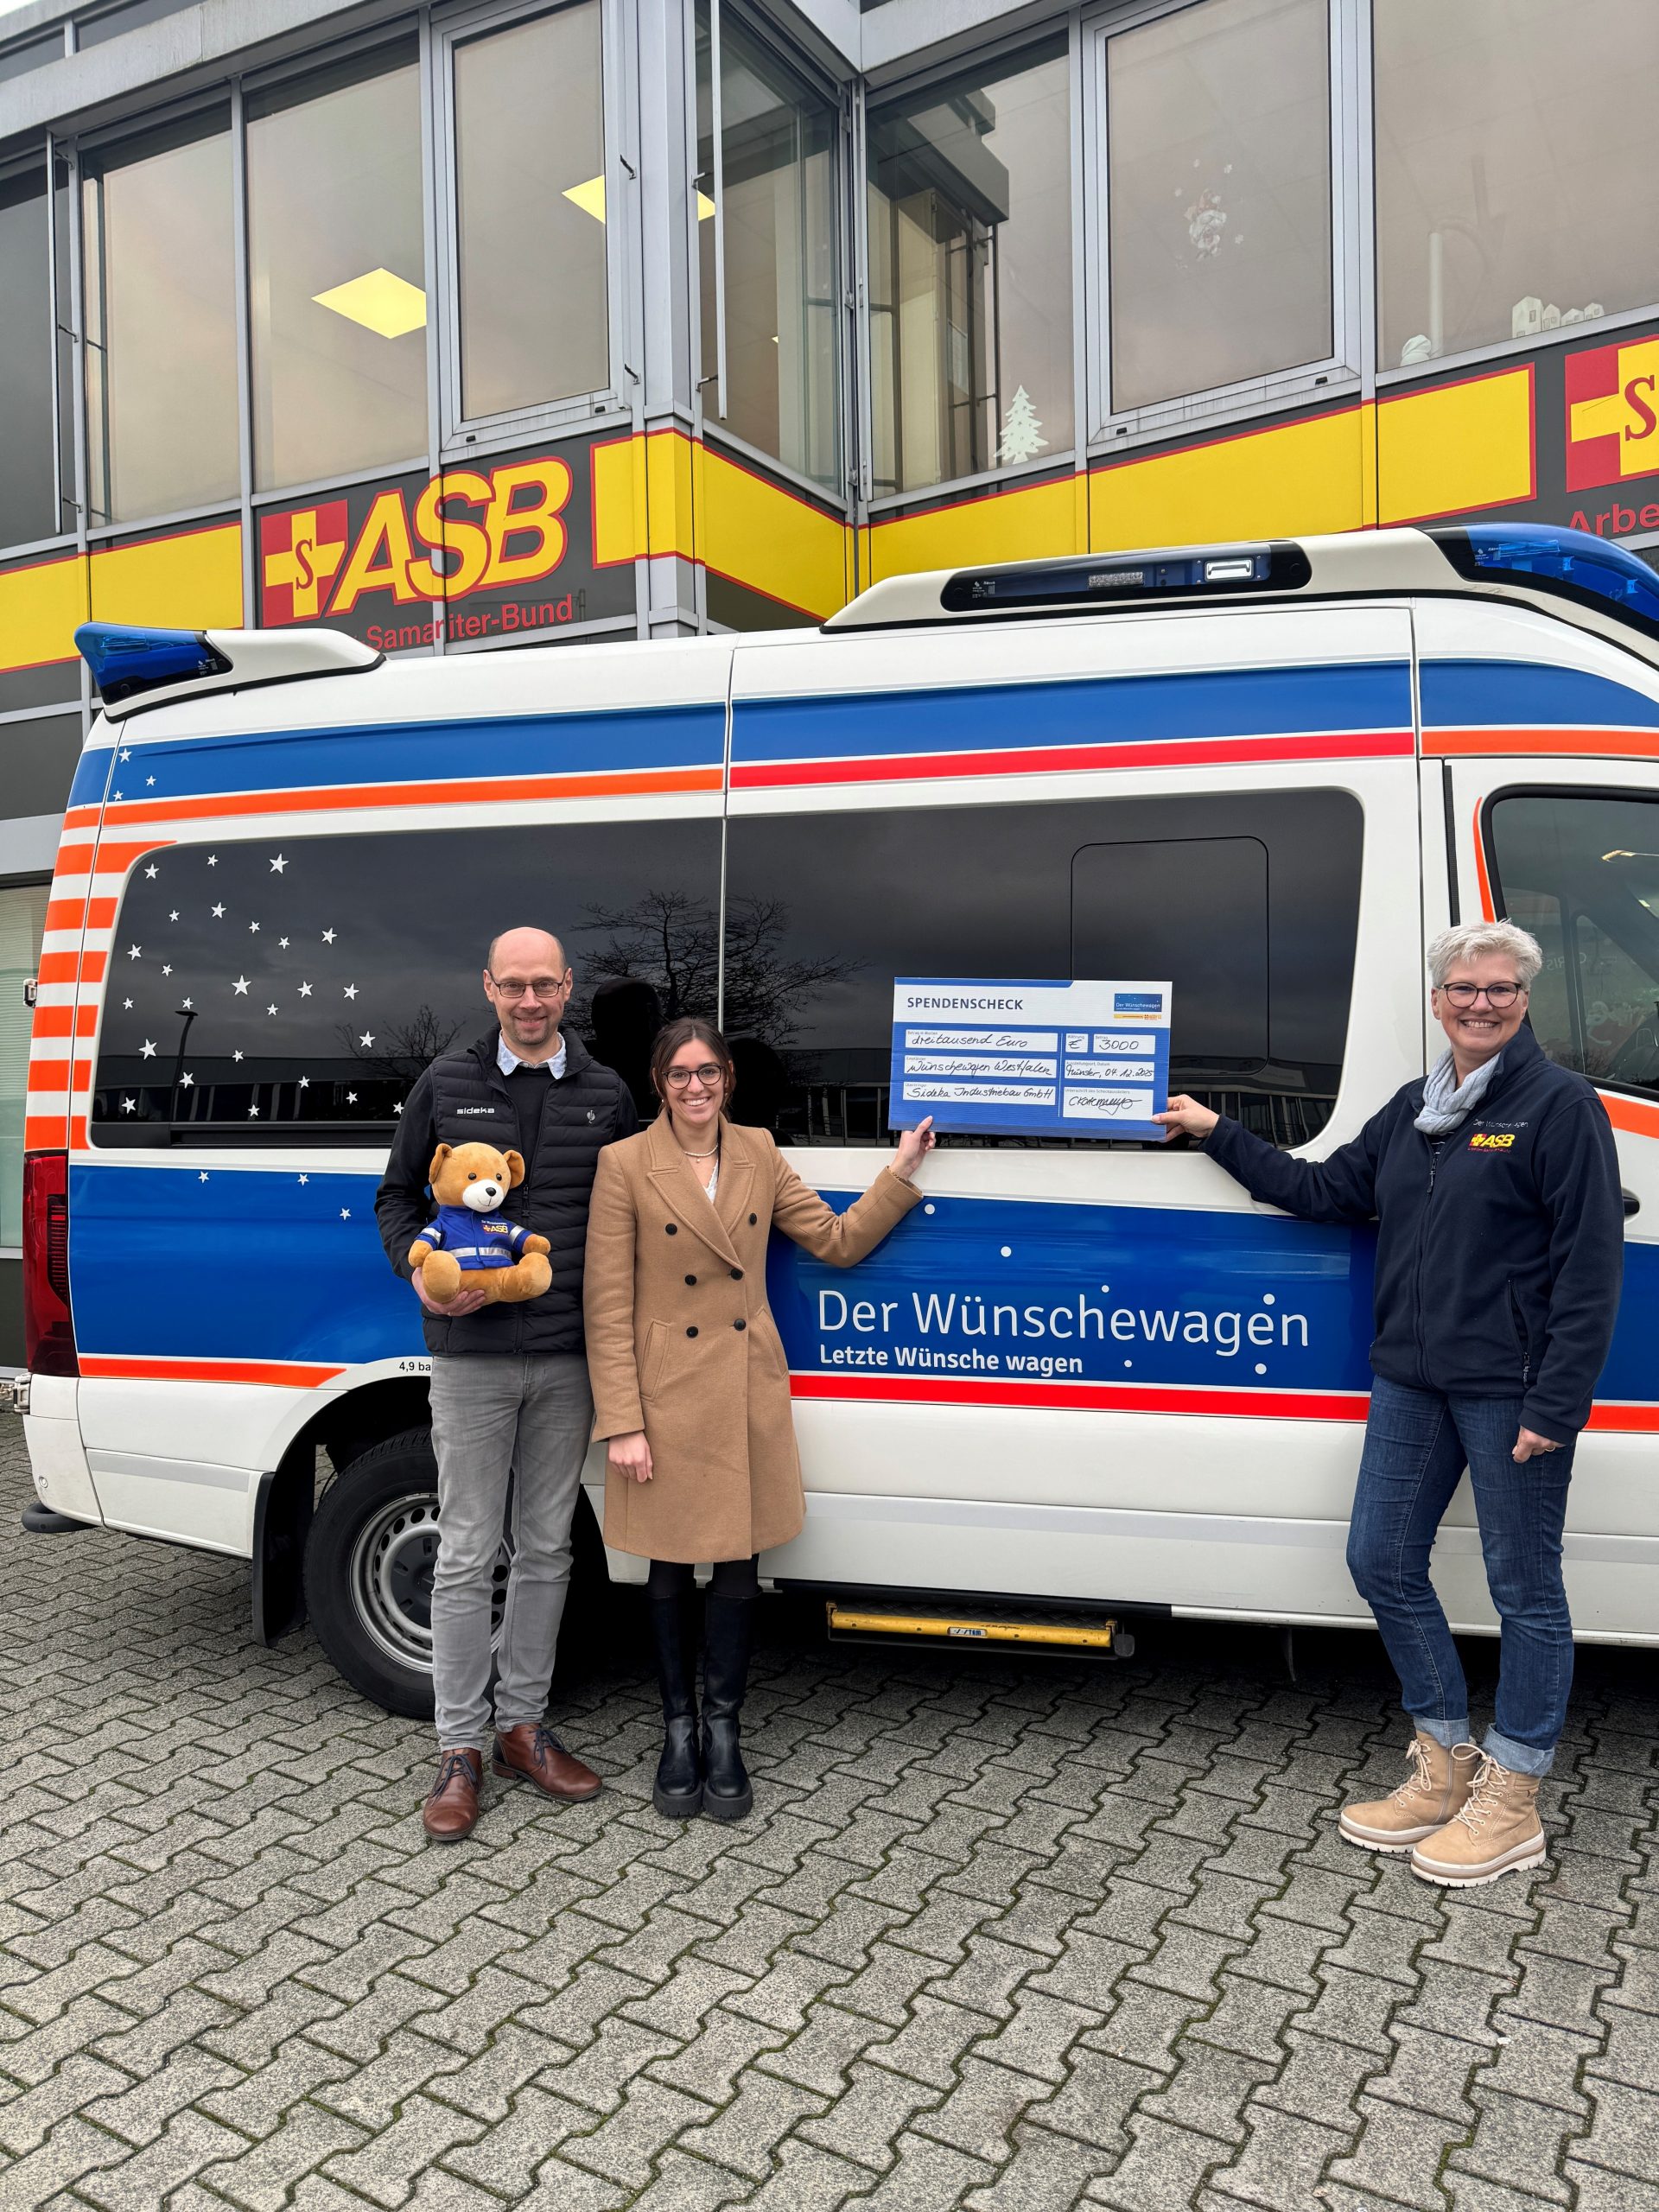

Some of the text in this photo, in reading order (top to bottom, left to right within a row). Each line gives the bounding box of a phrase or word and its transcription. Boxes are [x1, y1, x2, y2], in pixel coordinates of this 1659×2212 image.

[1569, 503, 1659, 537] Arbe
[325, 455, 573, 617] ASB
[907, 997, 1023, 1010] SPENDENSCHECK
[912, 1033, 1027, 1047] dreitausend Euro
[1099, 1039, 1139, 1050] 3000
[1023, 1088, 1054, 1099] GmbH
[1479, 1134, 1516, 1148] ASB
[490, 1225, 508, 1234] ASB
[818, 1290, 1309, 1357] Der Wünschewagen
[398, 1362, 431, 1373] 4,9 ba
[820, 1344, 1084, 1377] Letzte Wünsche wagen
